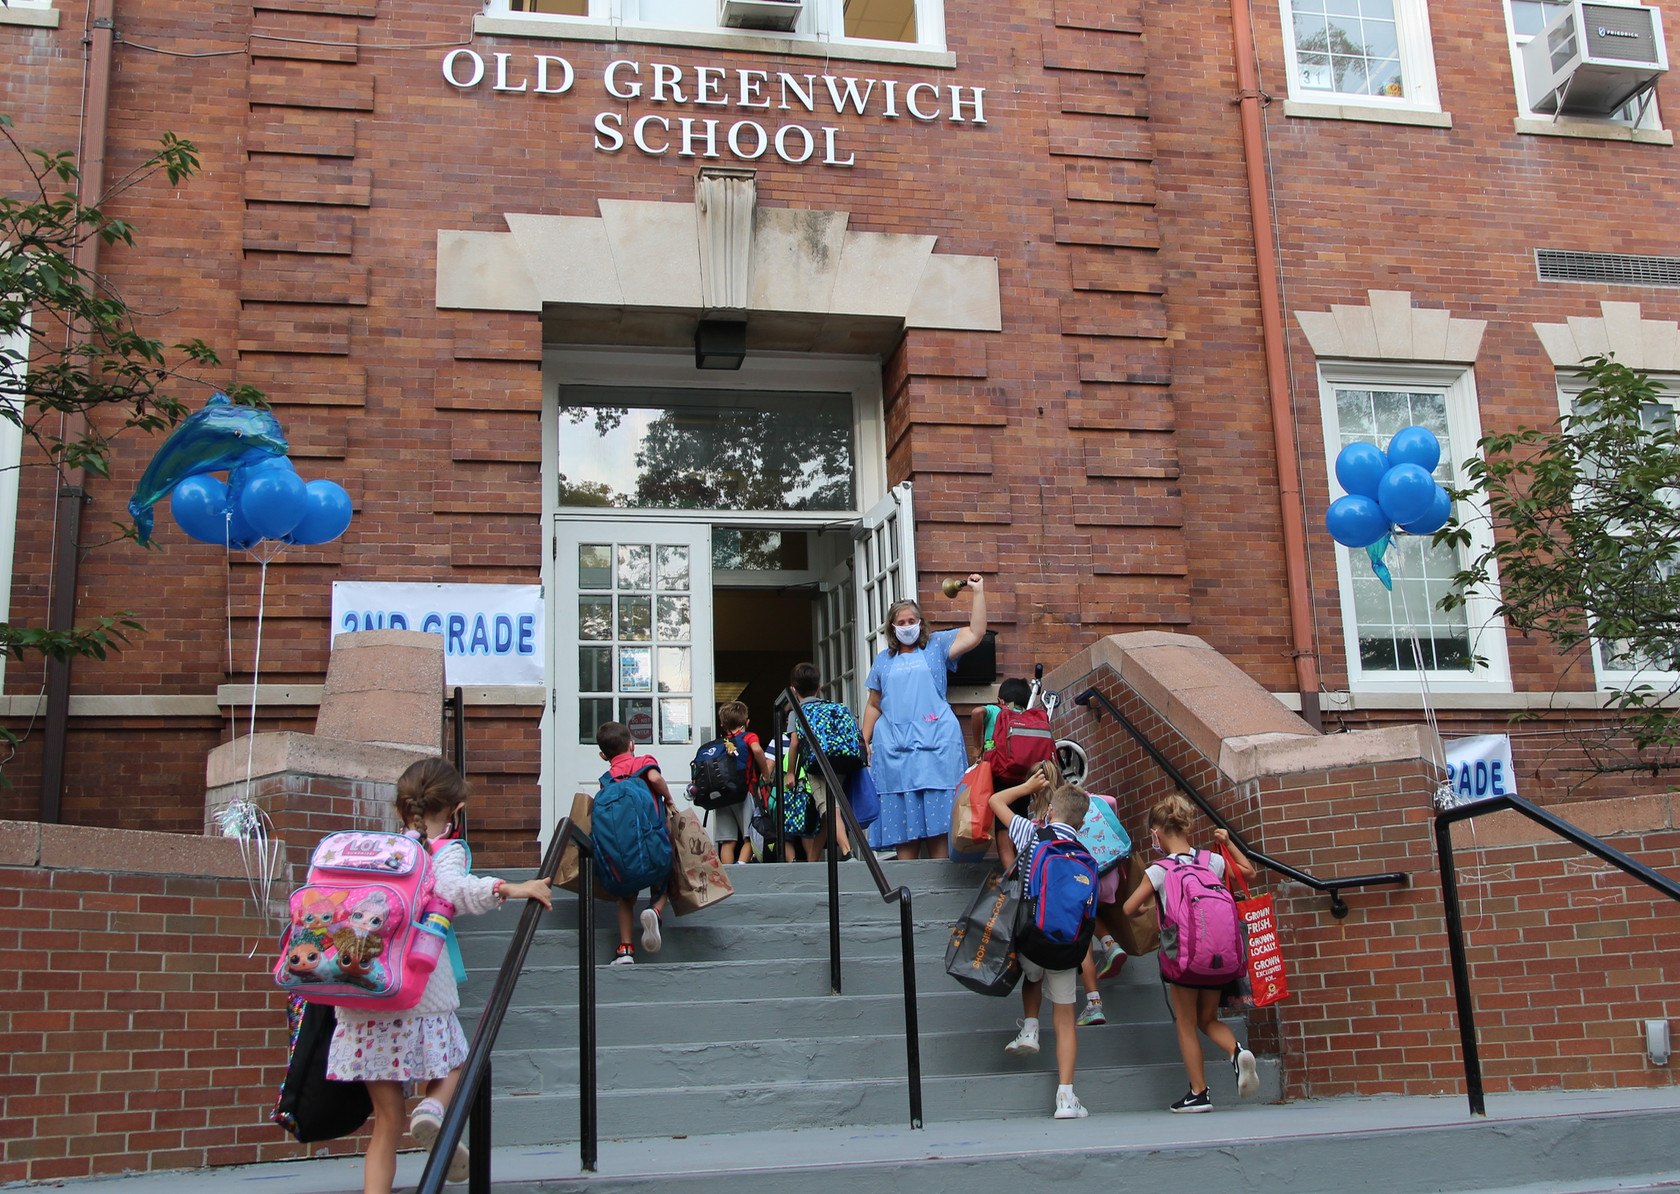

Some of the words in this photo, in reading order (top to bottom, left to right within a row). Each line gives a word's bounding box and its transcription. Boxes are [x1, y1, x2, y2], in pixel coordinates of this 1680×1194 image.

[1606, 30, 1639, 38] FRIEDRICH
[442, 48, 575, 95] OLD
[604, 60, 987, 124] GREENWICH
[593, 112, 855, 166] SCHOOL
[1245, 907, 1270, 922] GROWN
[1249, 932, 1275, 947] GROWN
[972, 945, 987, 969] SHOP
[1251, 942, 1277, 957] LOCALLY.
[1254, 955, 1280, 971] GROWN
